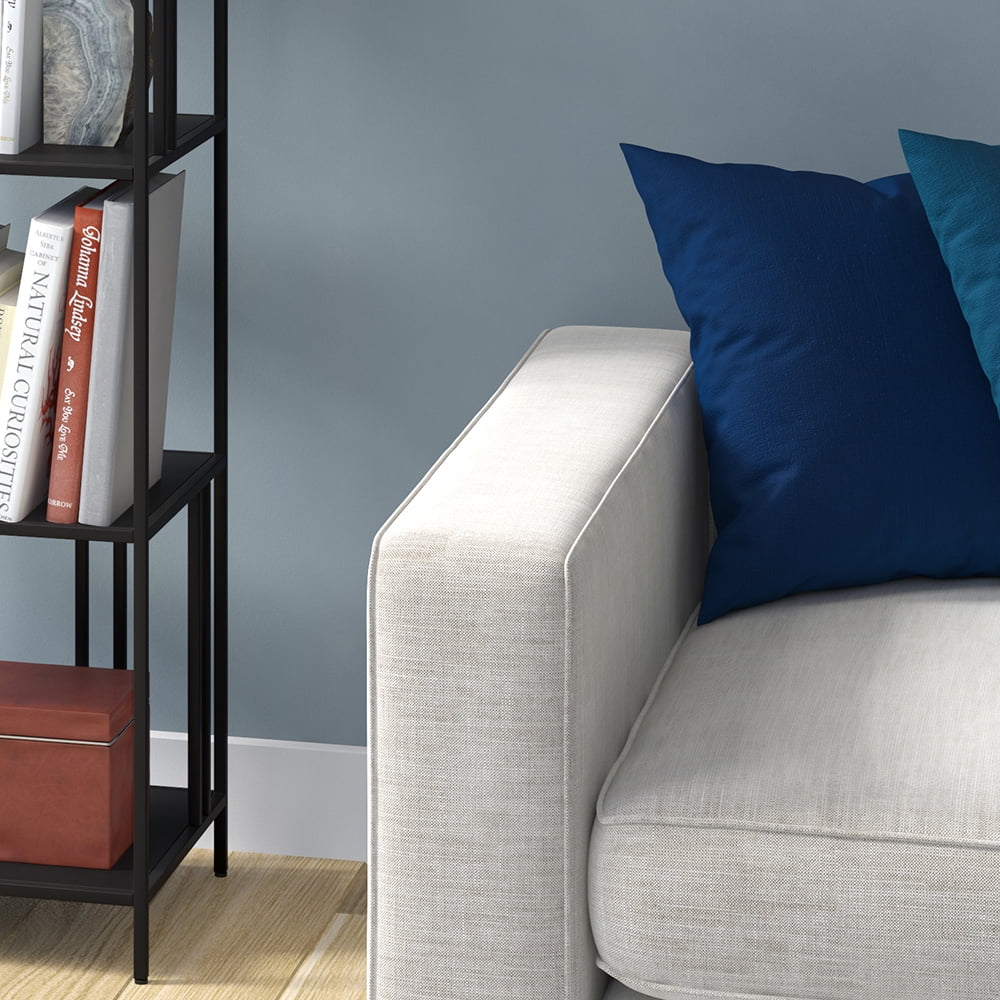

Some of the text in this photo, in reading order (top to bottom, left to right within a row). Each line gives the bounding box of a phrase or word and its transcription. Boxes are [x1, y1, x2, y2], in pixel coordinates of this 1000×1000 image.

[16, 270, 50, 374] NATURAL
[64, 225, 101, 343] Johanna Lindsey
